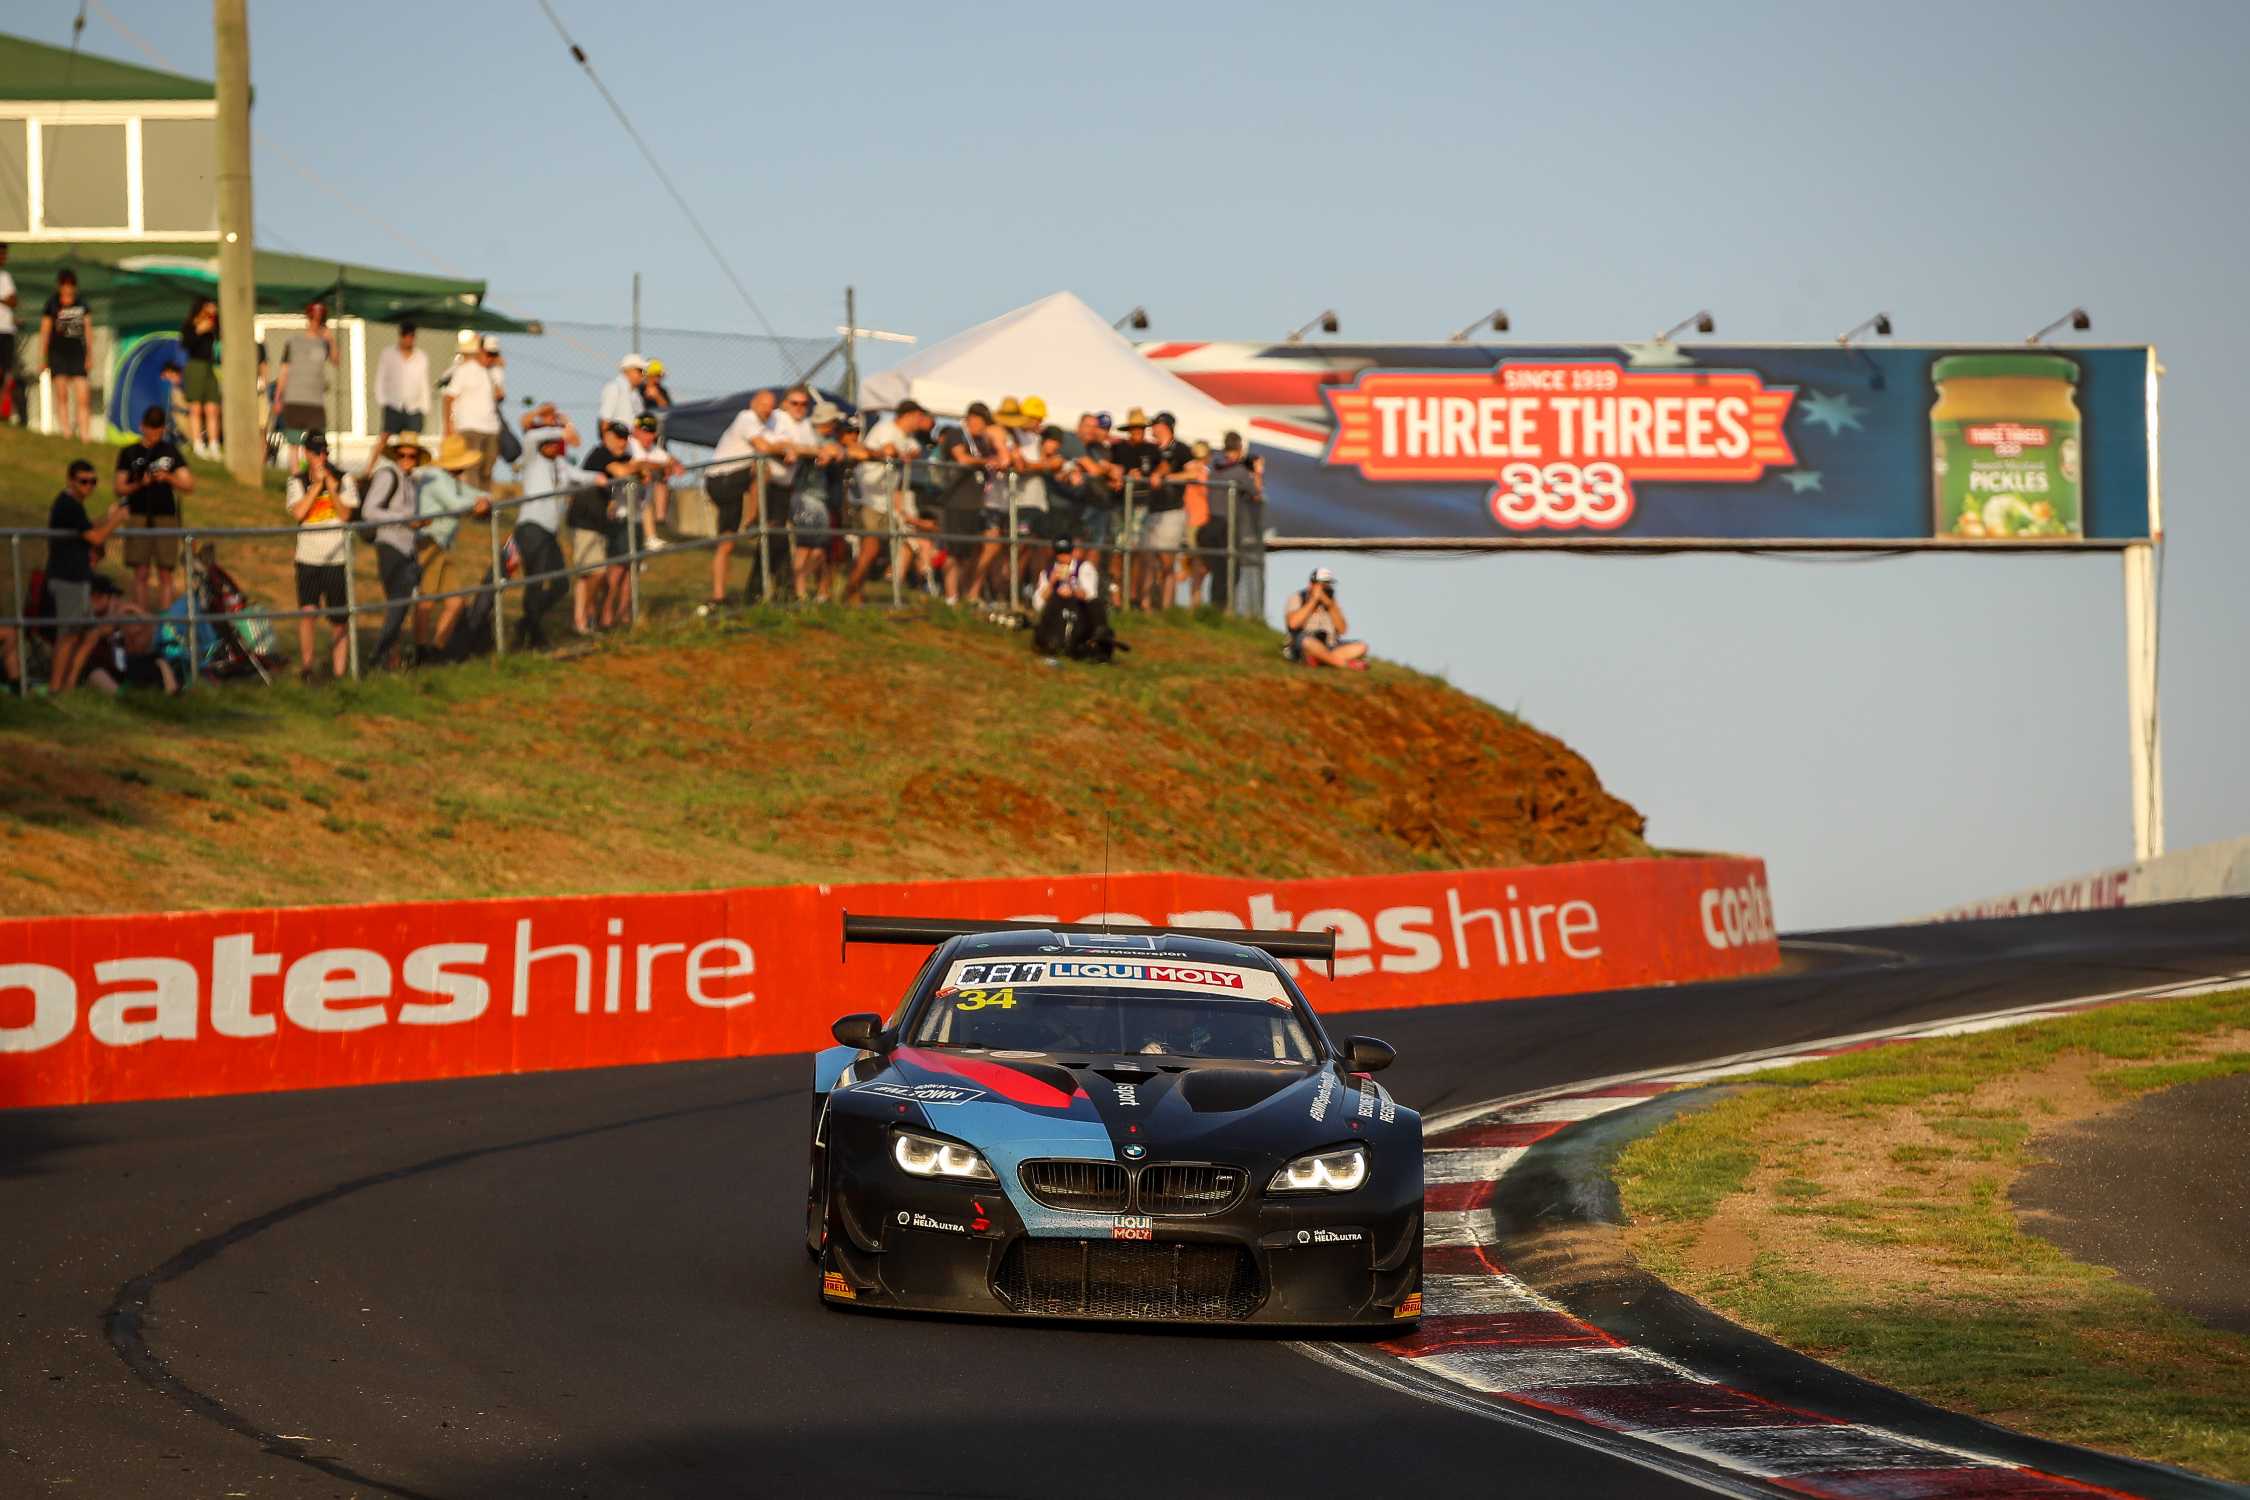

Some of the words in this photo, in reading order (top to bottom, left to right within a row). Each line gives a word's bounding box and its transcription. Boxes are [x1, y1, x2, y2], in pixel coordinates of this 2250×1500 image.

[1504, 369, 1565, 391] SINCE
[1374, 397, 1541, 457] THREE
[1550, 397, 1750, 457] THREES
[1969, 471, 2049, 492] PICKLES
[1497, 462, 1627, 525] 333
[1446, 886, 1602, 968] hire
[512, 919, 756, 1018] hire
[1053, 963, 1143, 979] LIQUI
[1149, 966, 1241, 987] MOLY
[956, 988, 1017, 1011] 34
[913, 1217, 938, 1229] HELIX
[939, 1222, 965, 1232] ULTRA
[1114, 1216, 1150, 1228] LIQUI
[1114, 1228, 1151, 1239] MOLY
[1315, 1232, 1339, 1242] HELIX
